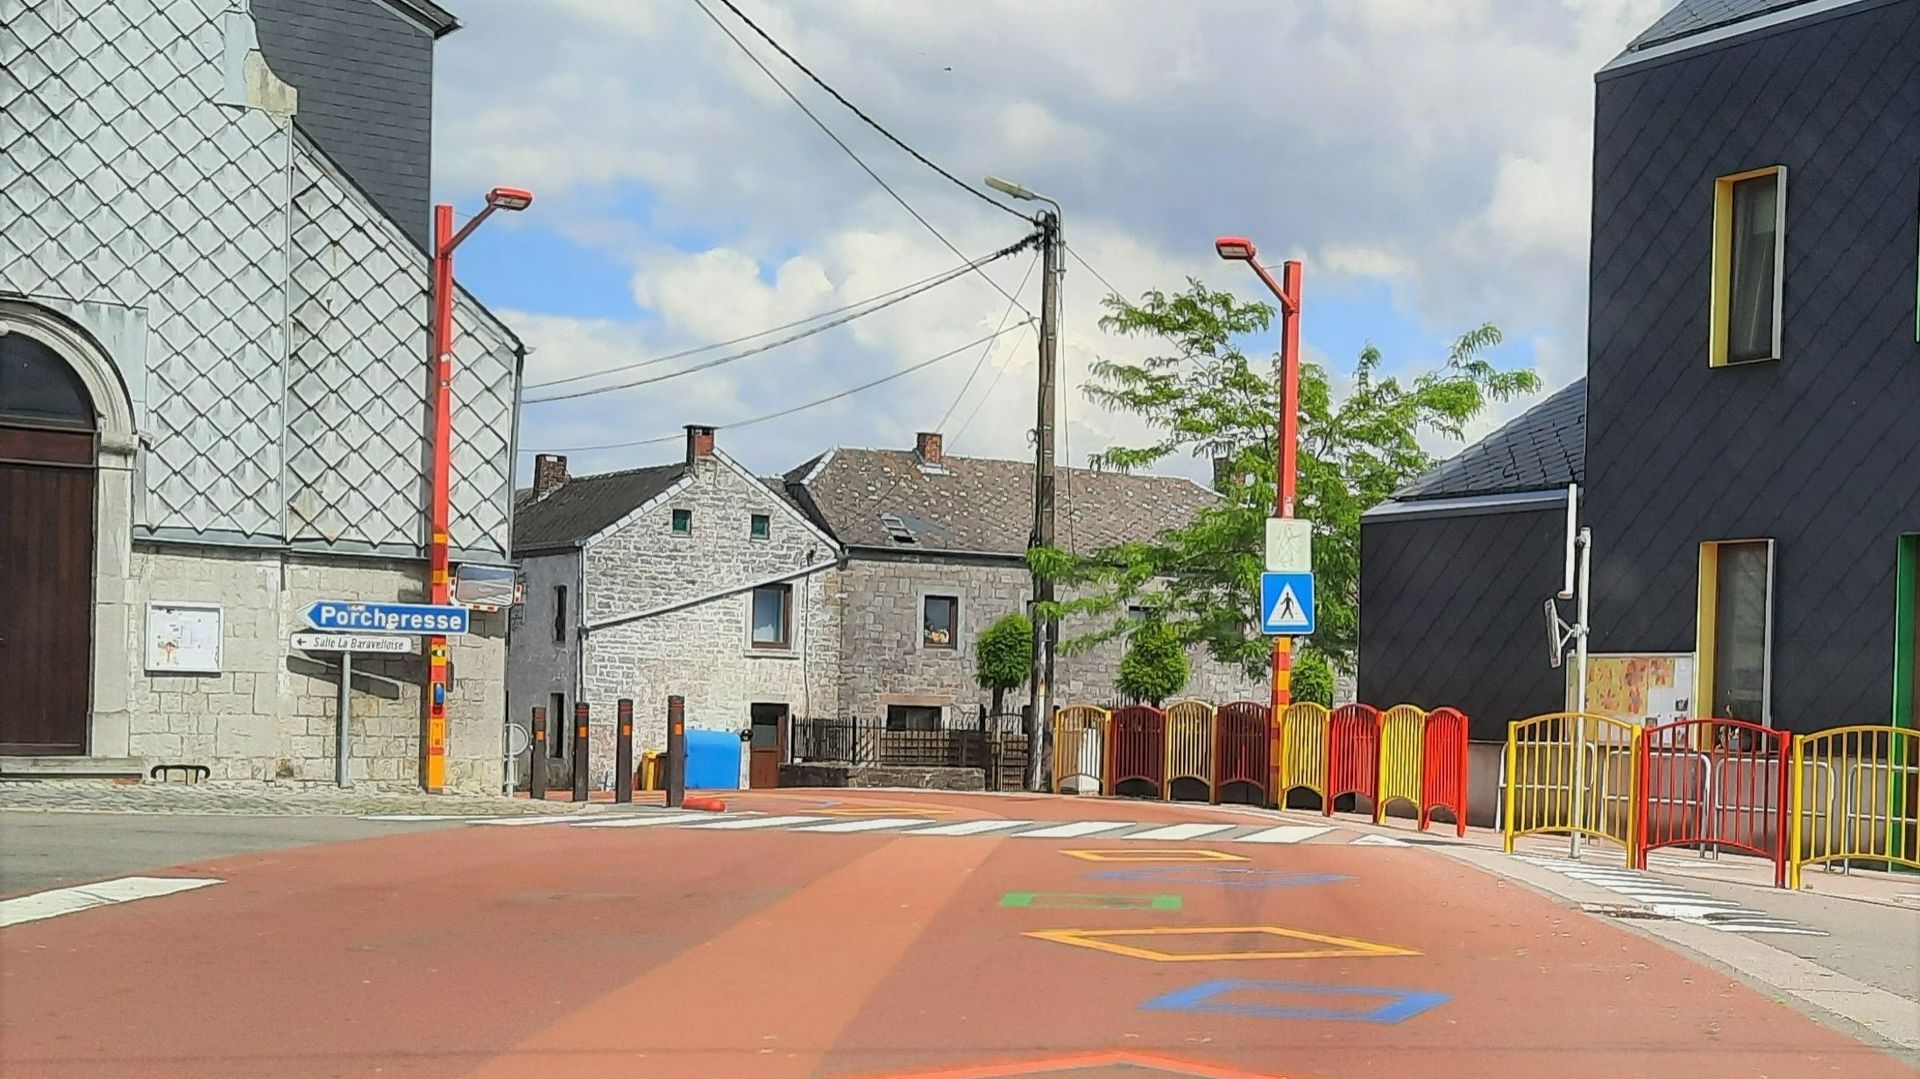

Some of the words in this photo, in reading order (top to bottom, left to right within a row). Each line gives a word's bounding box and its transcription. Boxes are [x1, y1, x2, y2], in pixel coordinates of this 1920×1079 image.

[320, 605, 462, 630] Porcheresse
[313, 636, 335, 648] Salle
[337, 637, 349, 648] La
